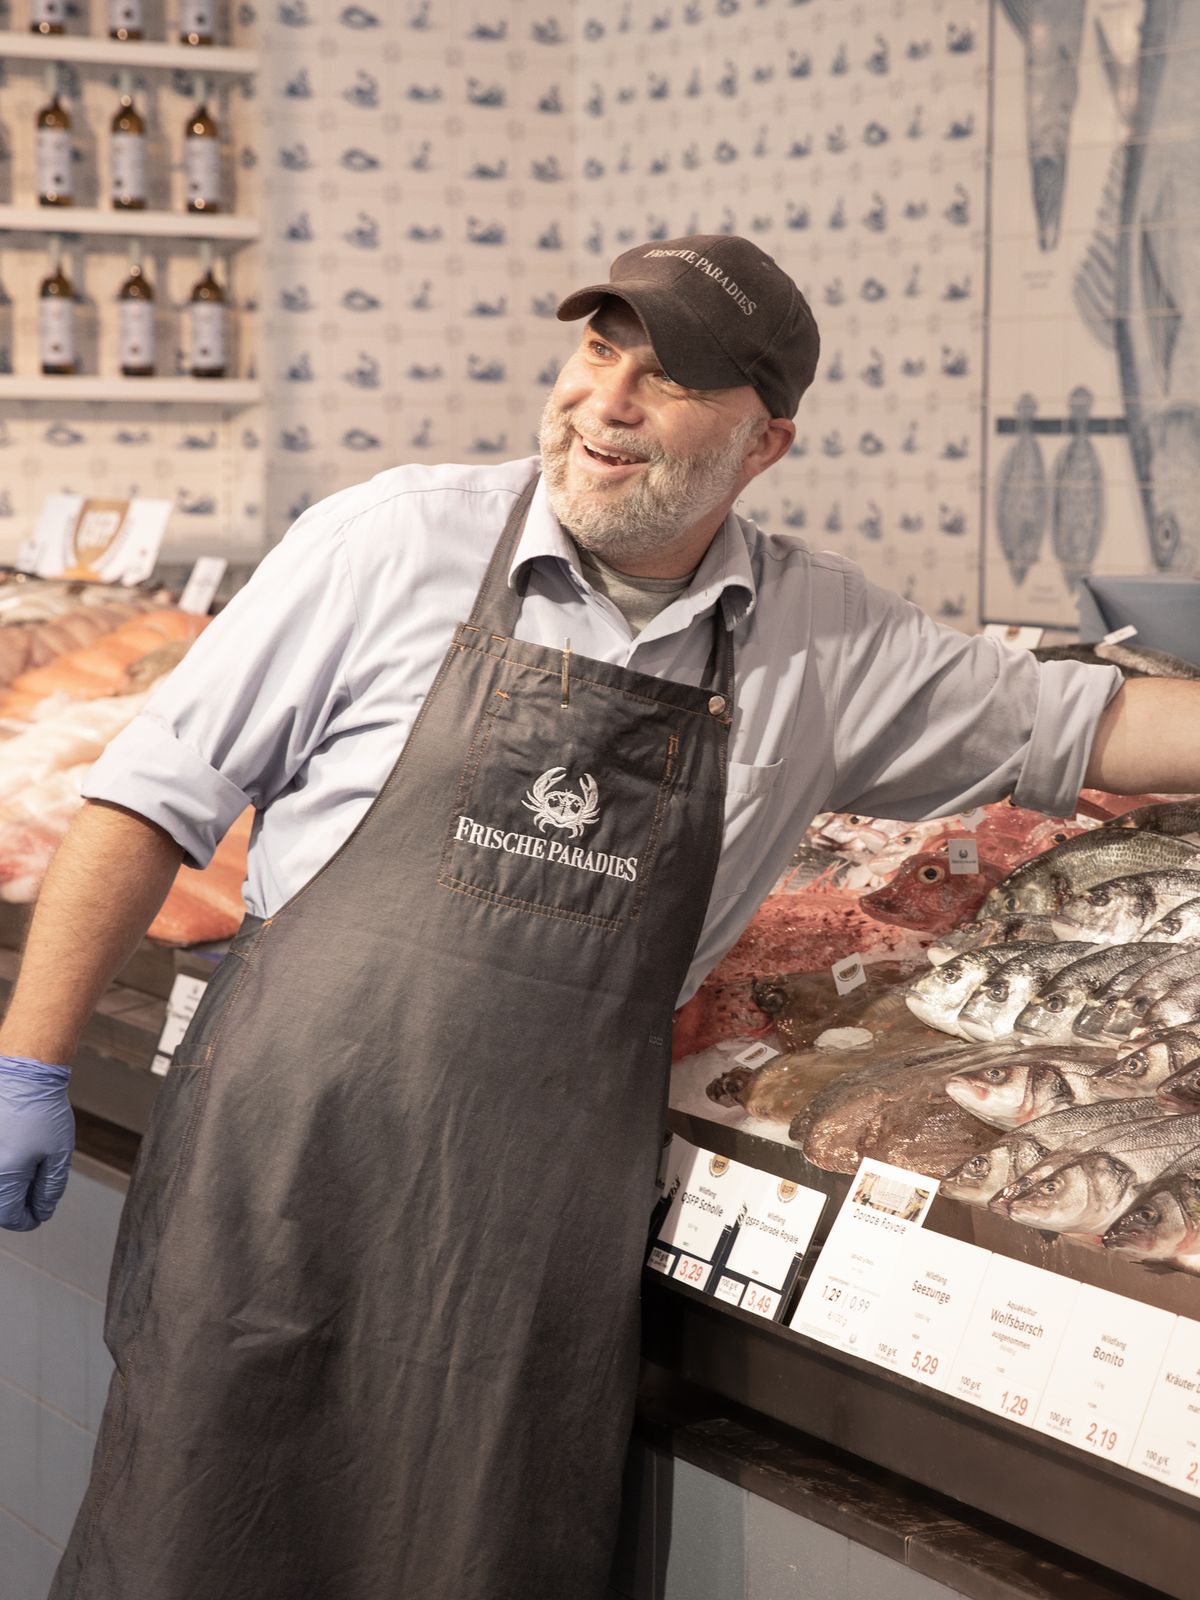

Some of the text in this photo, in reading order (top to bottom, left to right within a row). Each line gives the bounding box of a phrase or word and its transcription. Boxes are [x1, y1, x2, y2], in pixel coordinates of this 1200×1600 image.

[695, 257, 757, 316] PARADIES
[453, 815, 638, 882] FRISCHE PARADIES
[682, 1192, 724, 1217] QSFP Scholle
[759, 1221, 780, 1237] Dorade
[780, 1229, 799, 1245] Royale
[679, 1260, 703, 1282] 3,29
[747, 1290, 772, 1314] 3,49
[911, 1280, 951, 1305] Seezunge
[990, 1308, 1044, 1338] Wolfsbarsch
[911, 1350, 939, 1376] 5,29
[1092, 1346, 1125, 1368] Bonito
[1165, 1373, 1196, 1392] Kräuter
[1001, 1391, 1029, 1417] 1,29
[1085, 1422, 1117, 1450] 2,19
